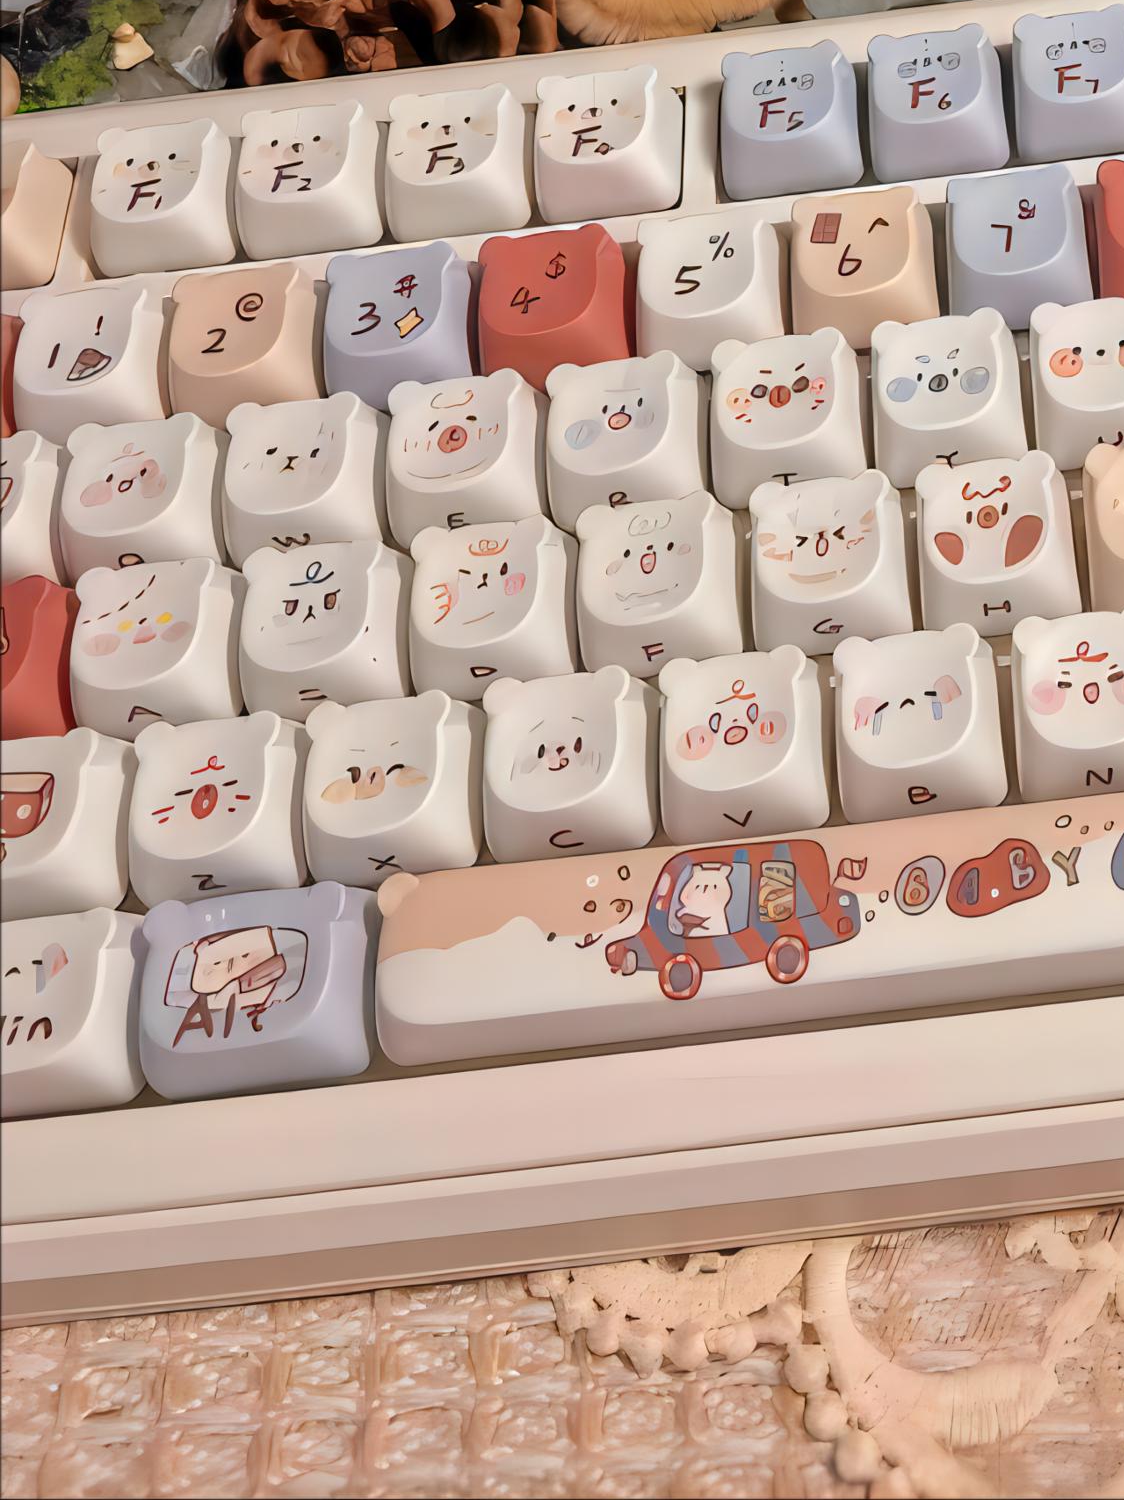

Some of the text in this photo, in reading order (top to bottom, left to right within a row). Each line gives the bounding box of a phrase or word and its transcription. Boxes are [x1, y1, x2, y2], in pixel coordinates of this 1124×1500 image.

[909, 77, 953, 111] F6
[1055, 63, 1100, 96] F7
[757, 96, 805, 131] F5
[271, 161, 312, 192] F2
[127, 179, 163, 212] F1
[990, 224, 1013, 253] 7
[837, 244, 863, 277] 6
[674, 265, 703, 295] 5
[234, 292, 265, 322] @
[509, 286, 542, 314] 4
[350, 301, 382, 337] 3
[200, 327, 227, 354] 2
[1085, 766, 1115, 787] N
[723, 808, 755, 828] V
[549, 828, 585, 849] C
[0, 1015, 53, 1046] in
[172, 992, 264, 1048] Alt
